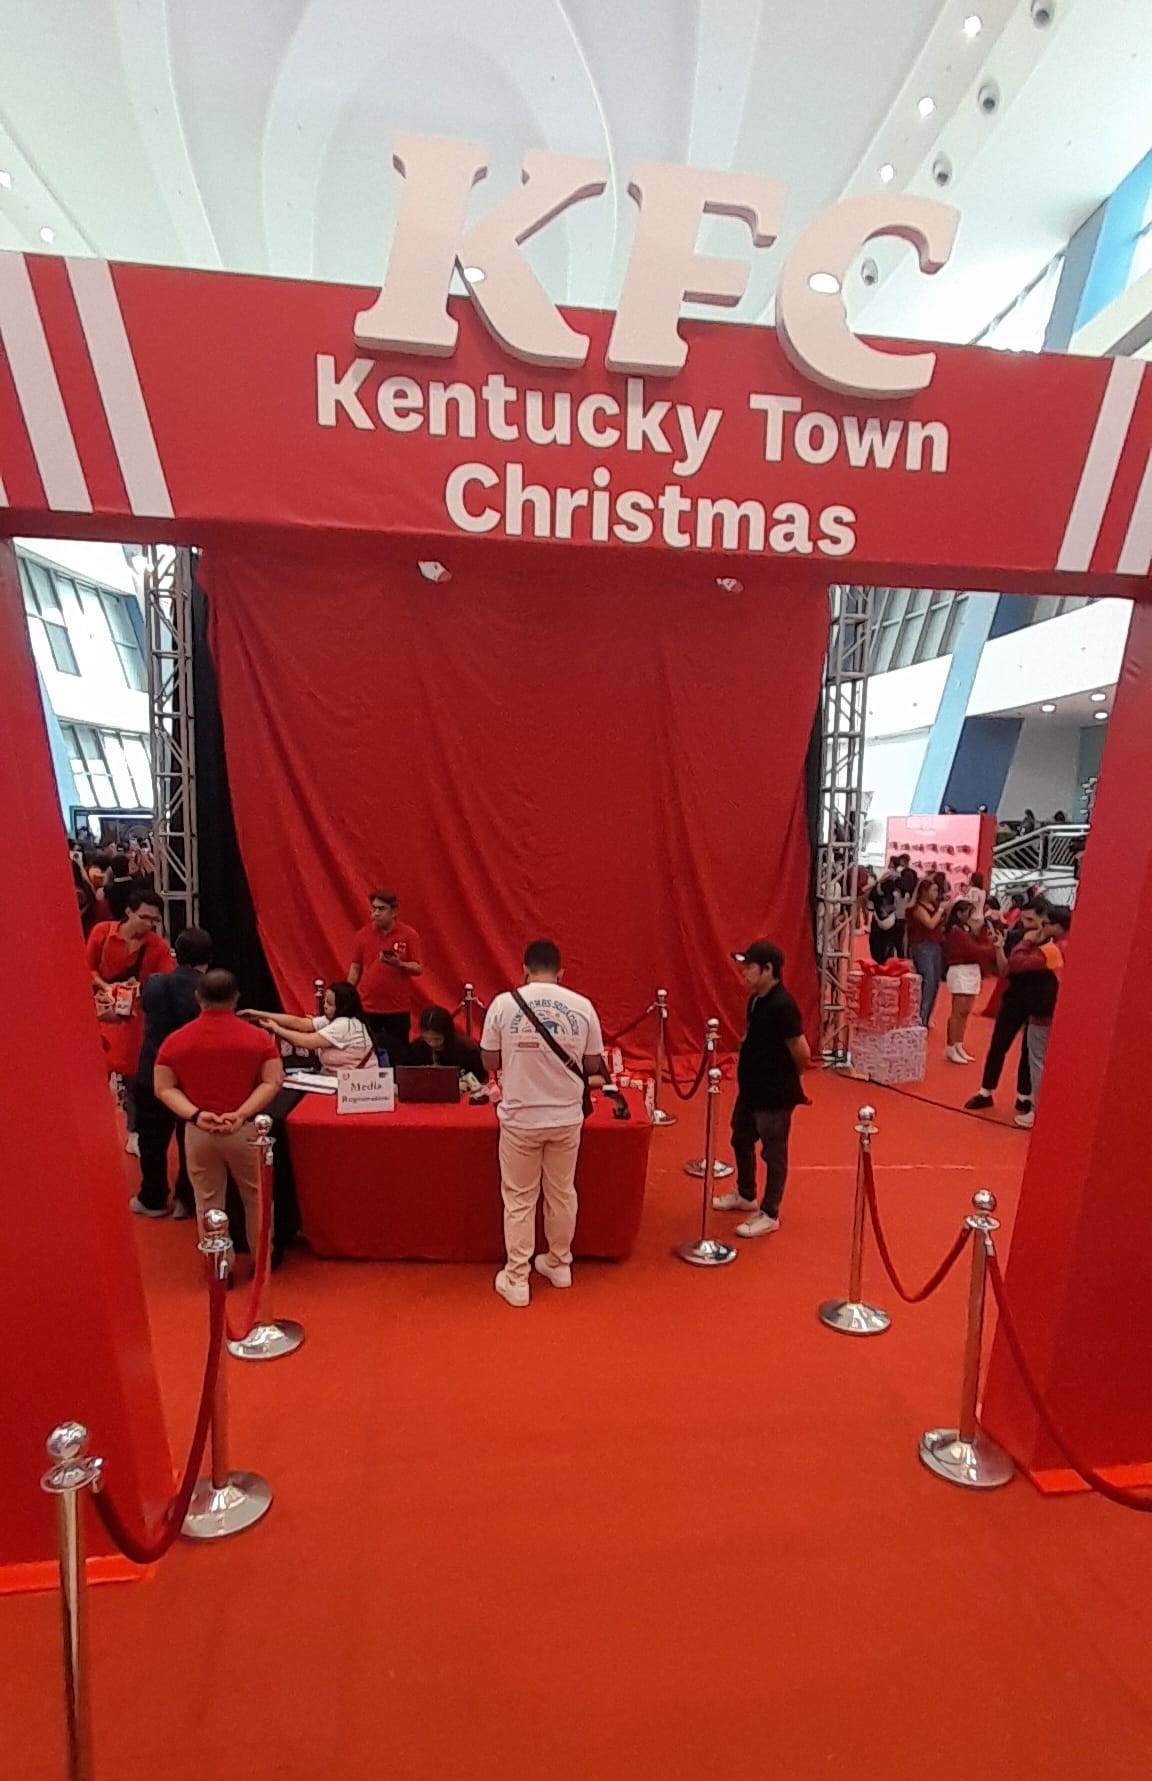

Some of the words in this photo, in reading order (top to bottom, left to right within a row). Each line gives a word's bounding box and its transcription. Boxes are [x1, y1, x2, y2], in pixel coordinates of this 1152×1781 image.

[354, 131, 961, 398] KFC
[315, 353, 723, 478] Kentucky
[749, 393, 949, 474] Town
[445, 461, 858, 557] Christmas
